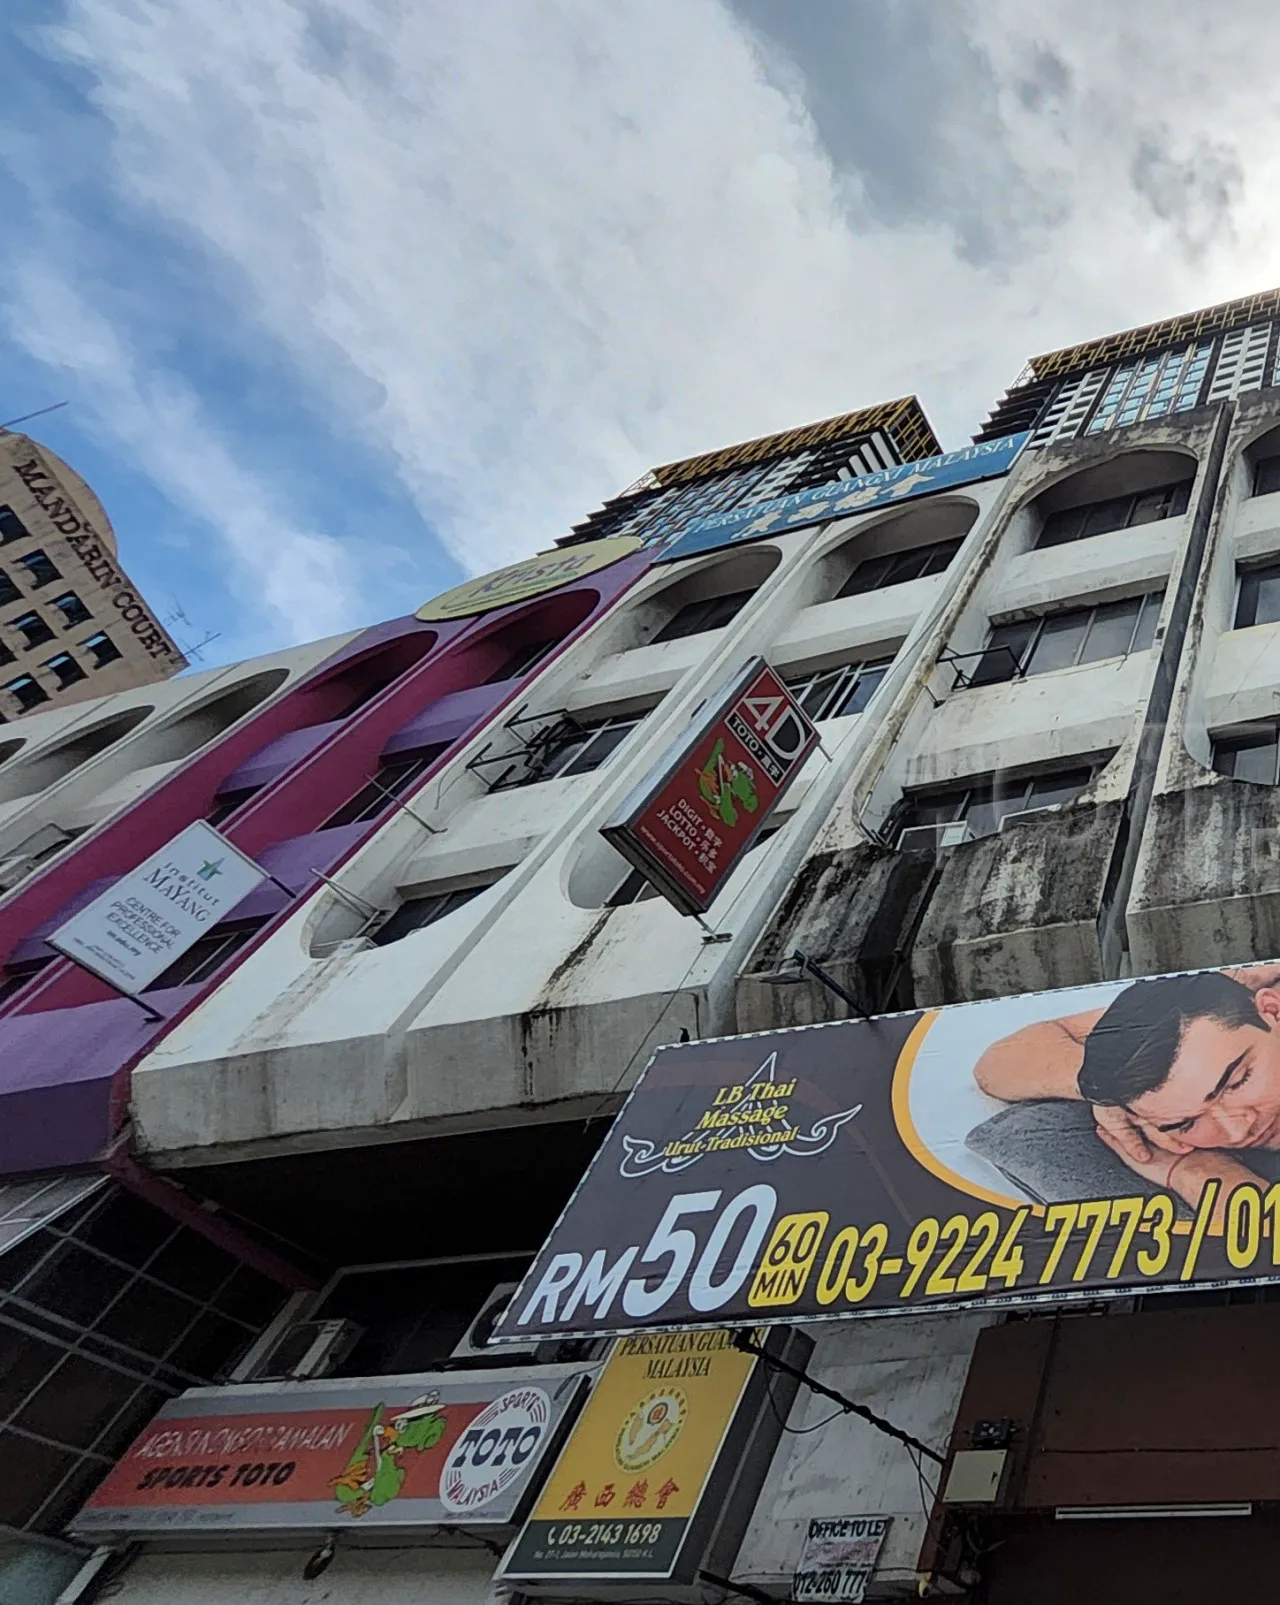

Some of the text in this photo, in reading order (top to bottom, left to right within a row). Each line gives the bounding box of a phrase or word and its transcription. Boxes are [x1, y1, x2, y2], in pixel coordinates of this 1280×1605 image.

[11, 458, 172, 660] MANDARIN COURT
[731, 715, 760, 752] TOTO
[668, 805, 698, 837] LOTTO
[677, 798, 703, 826] DIGIT
[656, 809, 697, 851] JACKPOT
[143, 867, 211, 922] MAYANG
[106, 912, 165, 954] EXCELLENCE
[111, 901, 178, 950] PROFESSIONAL
[126, 896, 181, 938] CENTRE FOR
[712, 1077, 798, 1107] LB Thai
[694, 1103, 789, 1131] Massage
[517, 1183, 777, 1326] RM50
[768, 1220, 819, 1264] 60
[815, 1208, 1031, 1305] 03-9224
[757, 1264, 803, 1299] MIN
[618, 1332, 694, 1357] PERSATUAN
[643, 1356, 712, 1380] MALAYSIA
[499, 1391, 541, 1414] SPORTS
[451, 1425, 541, 1468] TOTO
[136, 1461, 297, 1491] SPORTS TOTO
[446, 1480, 500, 1506] MALAYSIA
[558, 1523, 662, 1546] 03-2143 1698
[808, 1520, 848, 1540] OFFICE
[848, 1520, 866, 1538] TO
